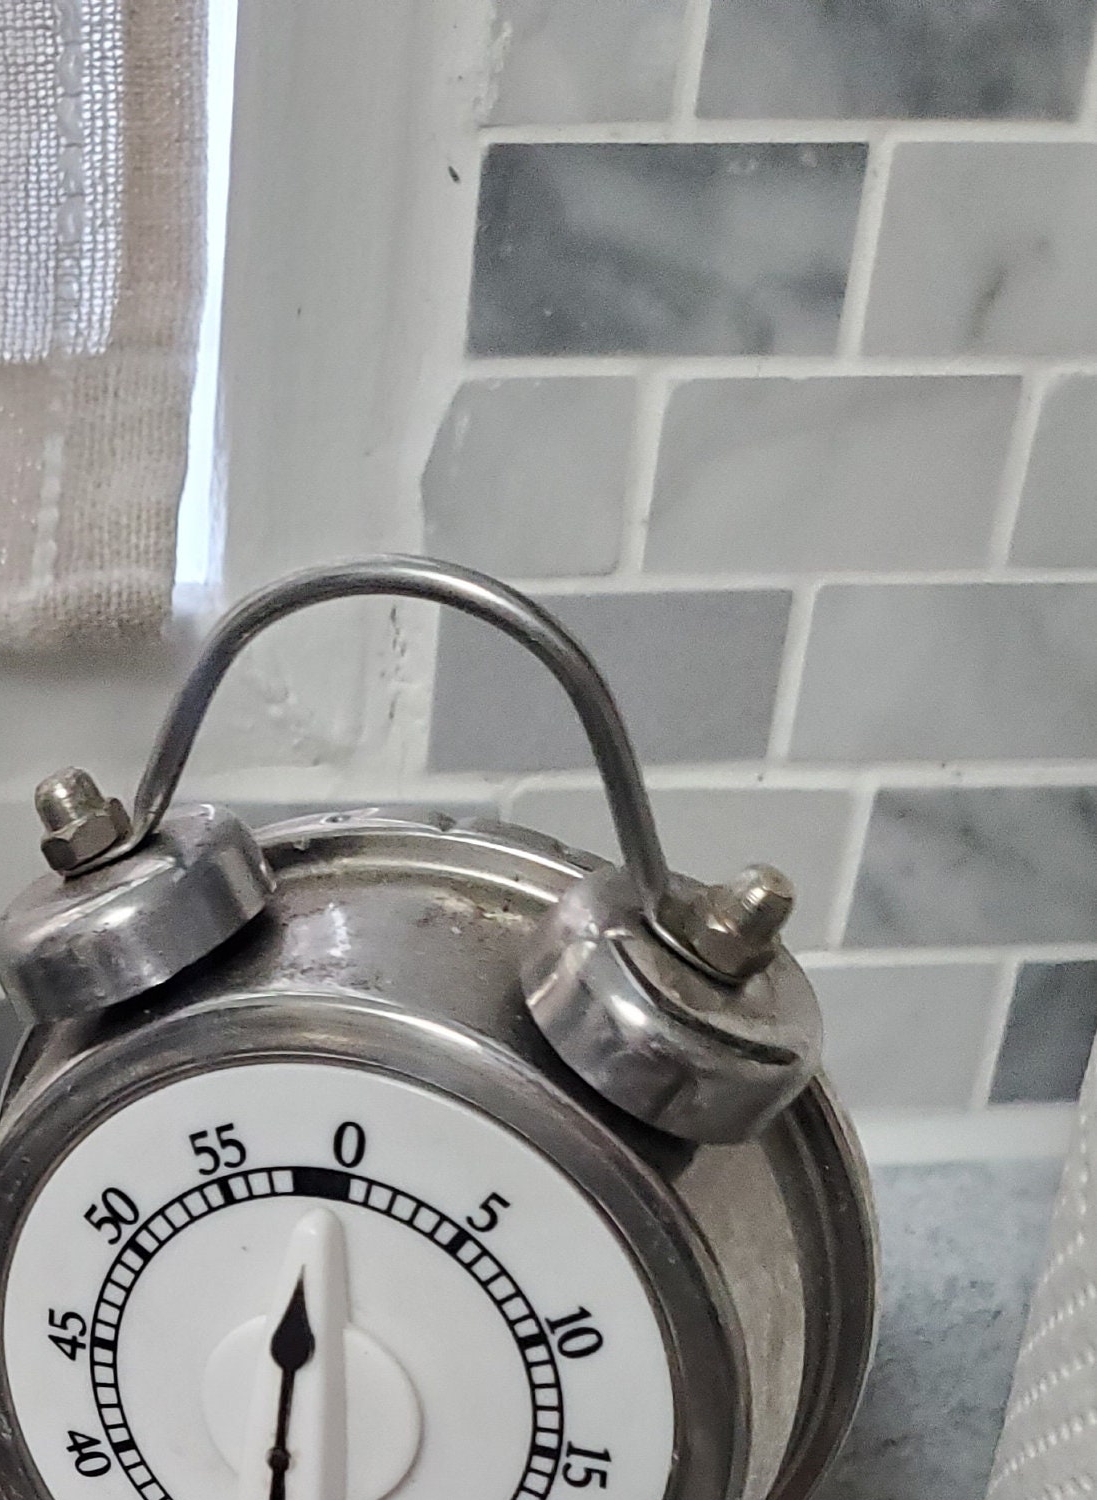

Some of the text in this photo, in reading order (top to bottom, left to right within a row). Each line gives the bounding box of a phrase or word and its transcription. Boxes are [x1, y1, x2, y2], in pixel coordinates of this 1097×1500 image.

[188, 1122, 247, 1176] 55
[332, 1121, 367, 1168] 0
[83, 1187, 141, 1245] 50
[465, 1191, 511, 1233] 5
[47, 1308, 88, 1362] 45
[544, 1306, 604, 1360] 10
[66, 1429, 112, 1478] 40
[561, 1439, 612, 1490] 15
